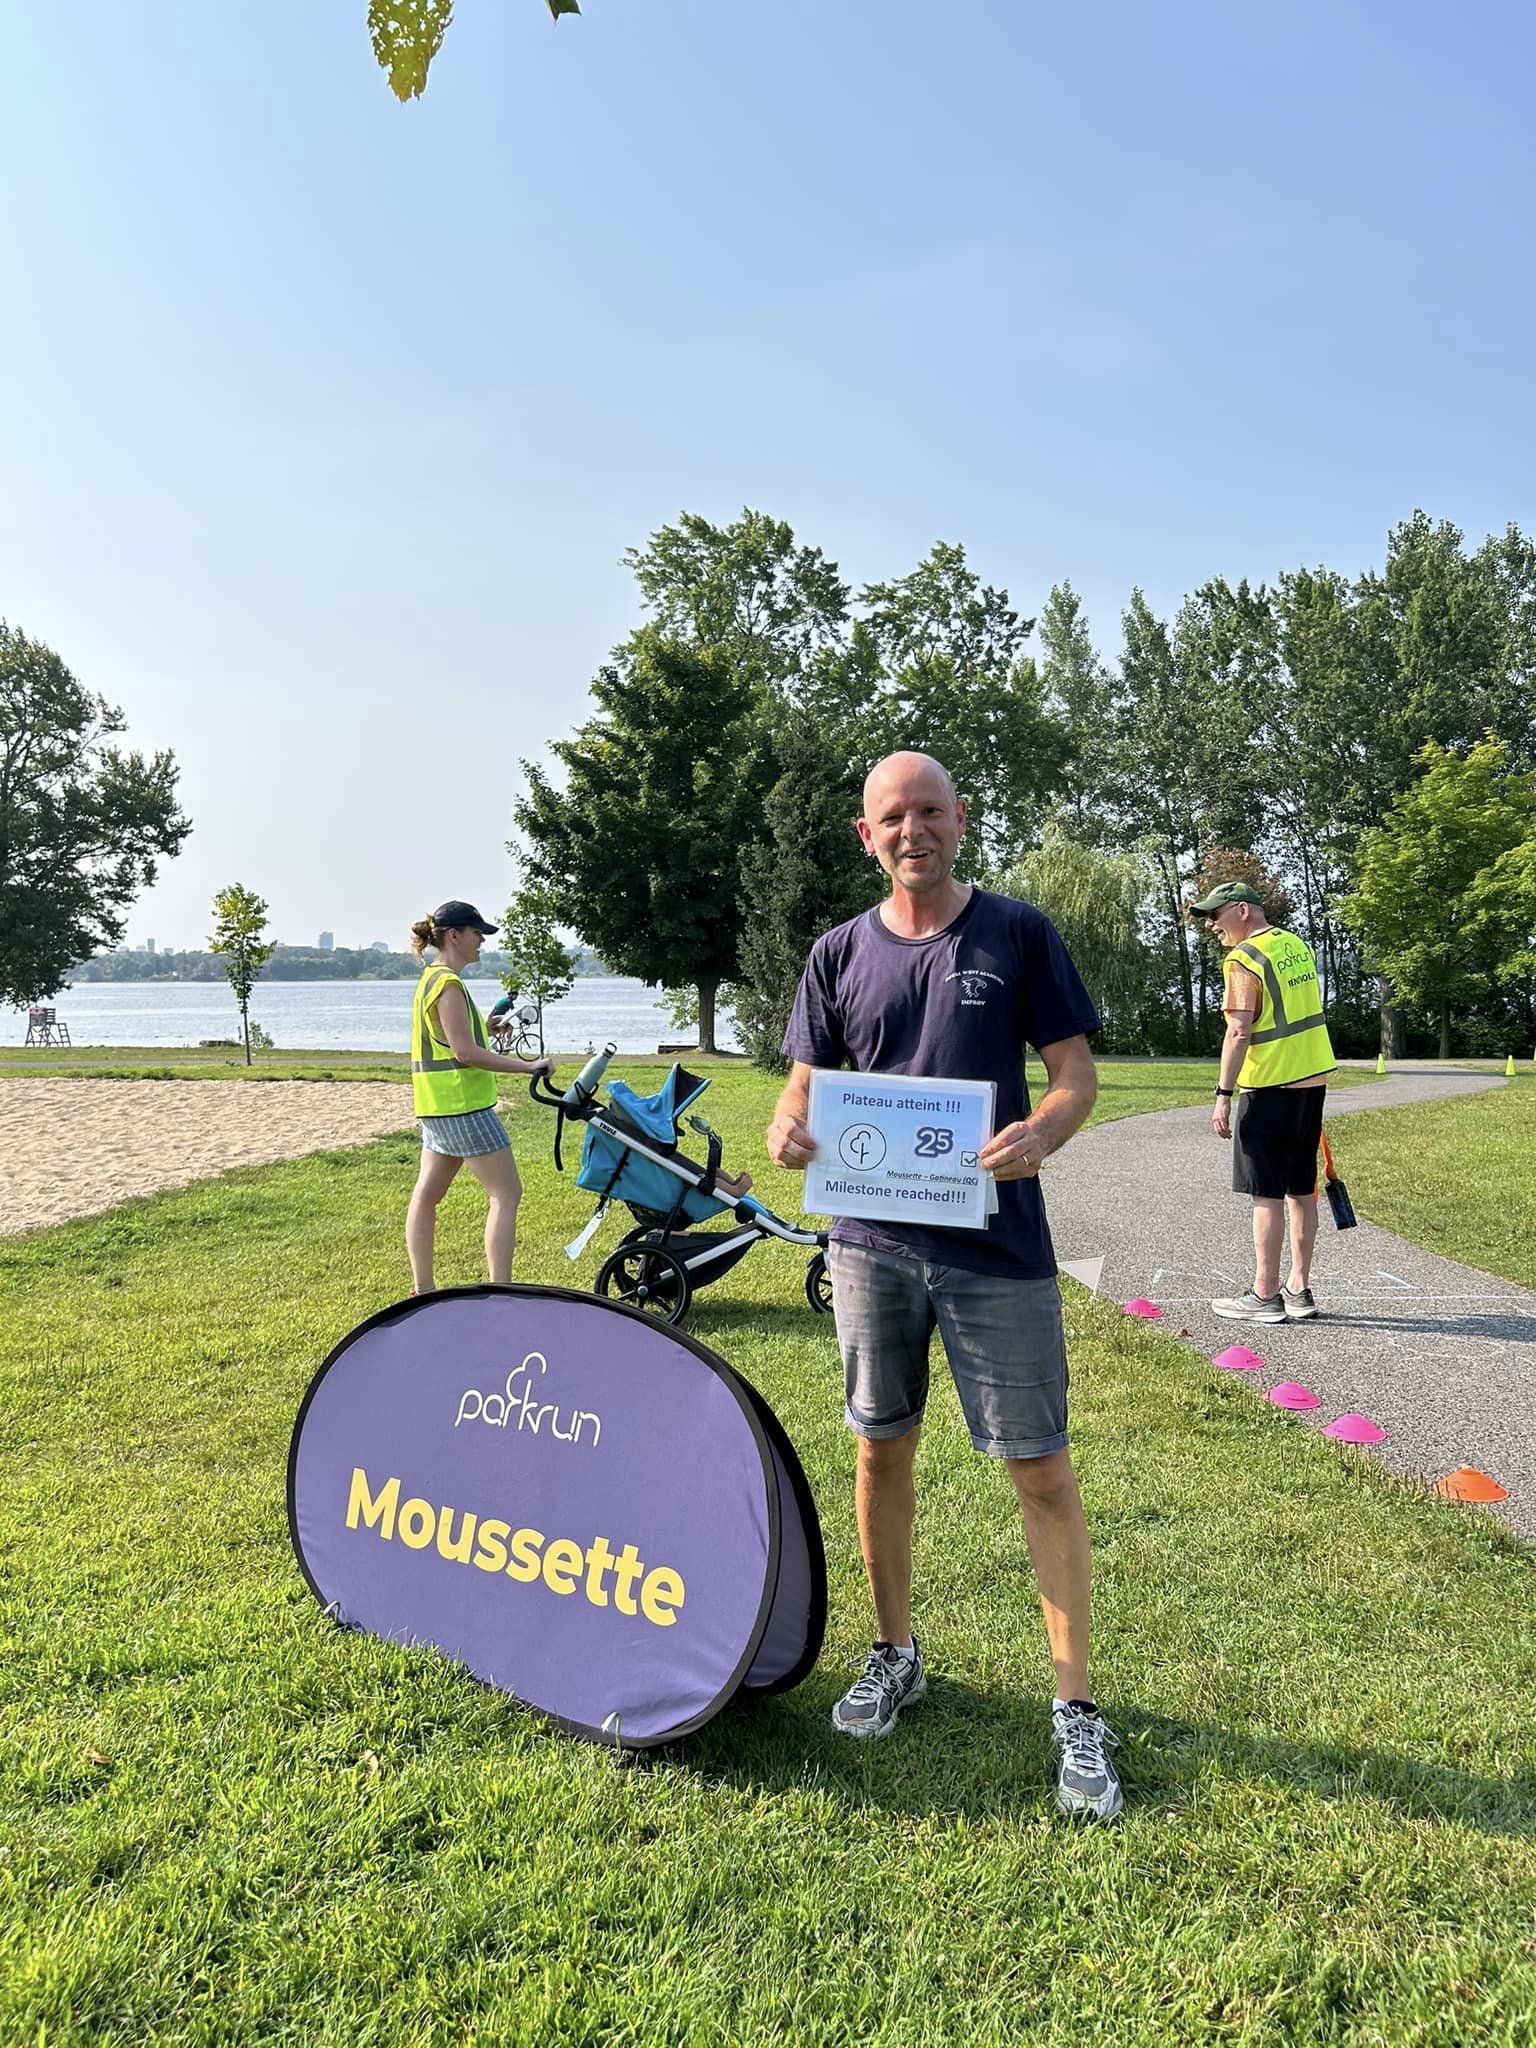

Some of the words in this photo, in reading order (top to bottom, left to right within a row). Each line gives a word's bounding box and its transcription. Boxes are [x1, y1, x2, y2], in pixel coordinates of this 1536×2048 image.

[843, 1093, 893, 1108] Plateau
[896, 1098, 942, 1112] atteint
[945, 1100, 961, 1113] !!!
[599, 1122, 617, 1136] THULE
[914, 1126, 954, 1158] 25
[887, 1170, 922, 1181] Moussette
[929, 1174, 961, 1184] Gatineau
[825, 1180, 892, 1197] Milestone
[895, 1188, 966, 1204] reached!!!
[455, 1352, 601, 1447] parkrun
[344, 1467, 686, 1626] Moussette
